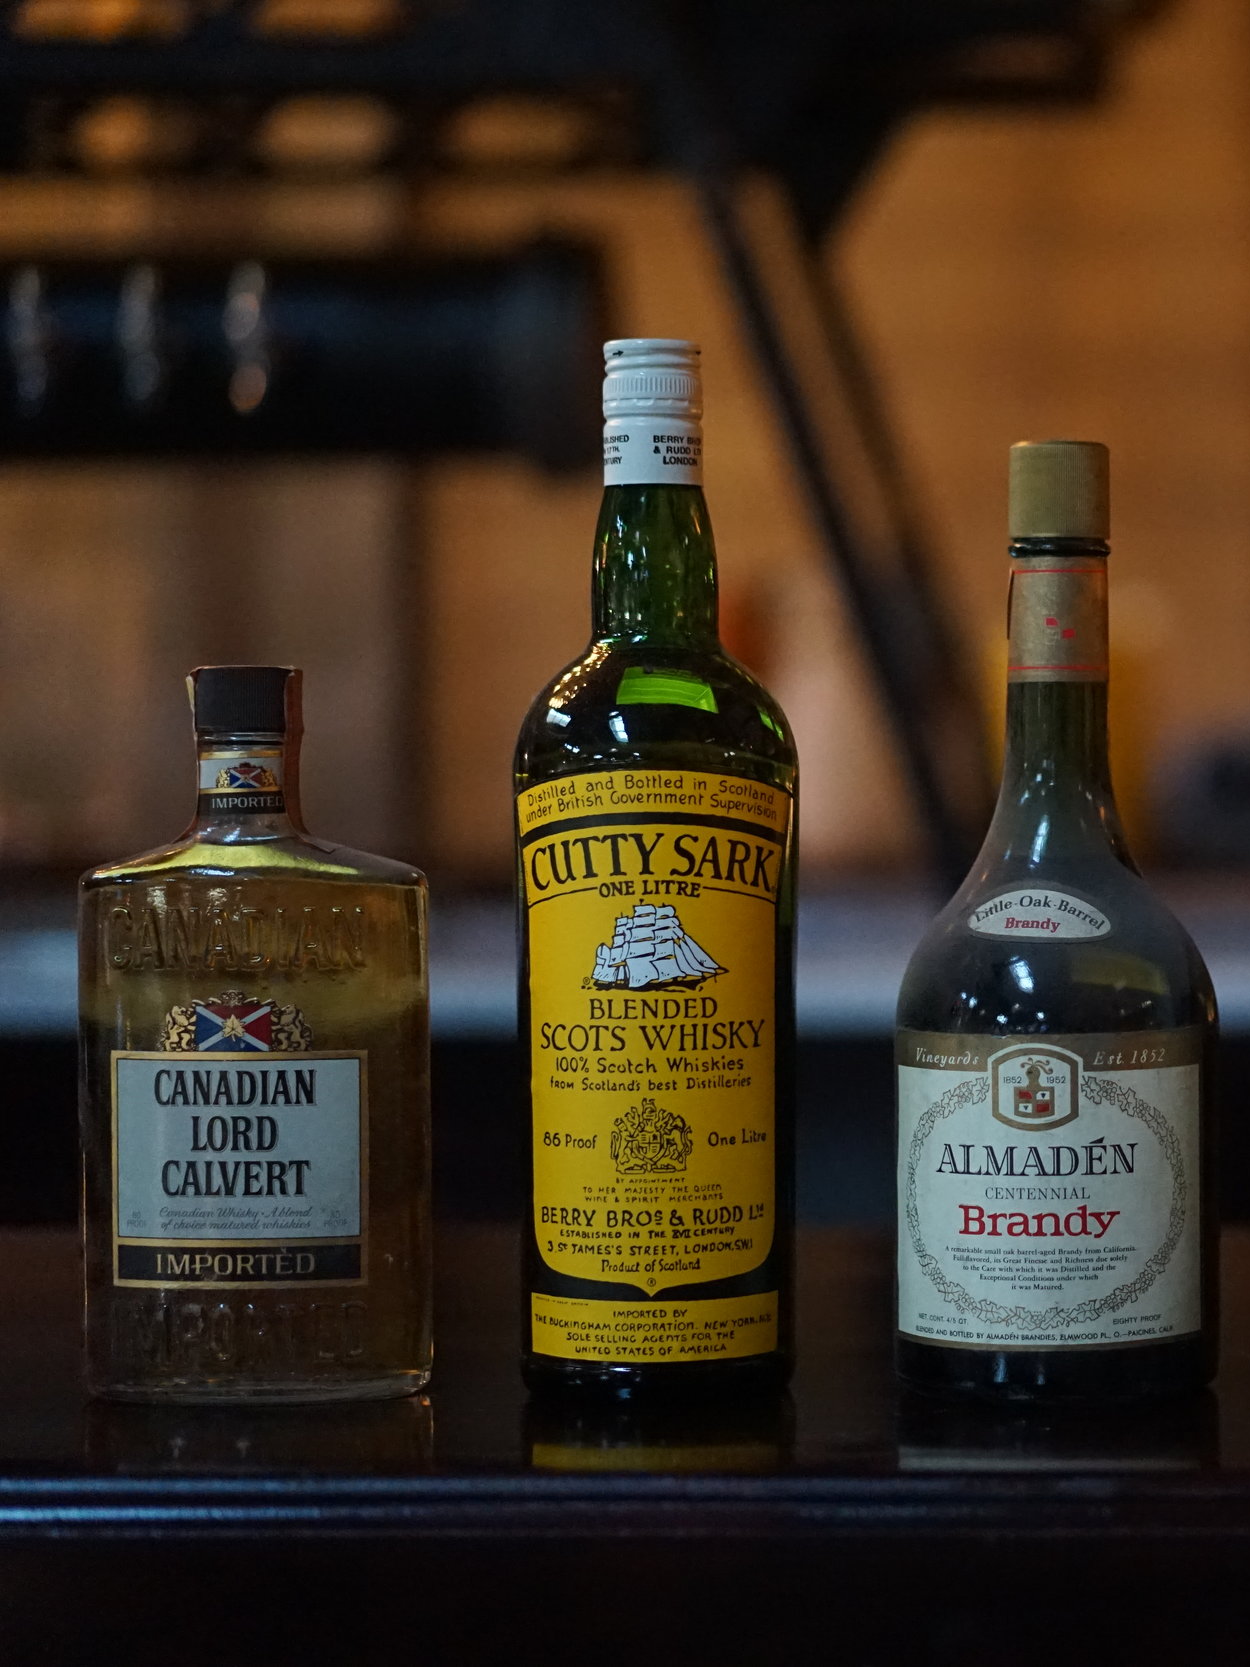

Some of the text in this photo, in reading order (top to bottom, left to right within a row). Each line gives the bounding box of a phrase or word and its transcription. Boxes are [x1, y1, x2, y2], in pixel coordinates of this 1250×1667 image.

[653, 435, 684, 444] BERRY
[653, 446, 691, 455] & RUDD
[663, 456, 698, 465] LONDON
[527, 775, 774, 806] Distilled and Bottled in Scotland
[212, 796, 282, 809] IMPORTED
[526, 791, 777, 823] under British Government Supervision
[531, 832, 775, 893] CUTTY SARK
[598, 880, 700, 898] ONE LITRE
[1005, 918, 1060, 932] Brandy
[589, 997, 718, 1020] BLENDED
[541, 1019, 765, 1052] SCOTS WHISKY
[915, 1047, 979, 1067] Vineyards
[1131, 1048, 1166, 1064] 1852
[556, 1056, 744, 1074] 100% Scotch Whiskies
[154, 1069, 317, 1106] CANADIAN
[582, 1078, 640, 1091] Scotland's
[649, 1079, 677, 1091] best
[686, 1075, 751, 1090] Distilleries
[1003, 1076, 1022, 1084] 1852
[1046, 1076, 1066, 1084] 1952
[191, 1115, 279, 1152] LORD
[543, 1133, 598, 1149] 86 Proof
[708, 1128, 766, 1146] One Litre
[936, 1136, 1138, 1177] ALMADÉN
[161, 1160, 310, 1197] CALVERT
[985, 1187, 1090, 1200] CENTENNIAL
[160, 1207, 214, 1218] Canadian
[542, 1206, 596, 1226] BERRY
[669, 1209, 684, 1226] &
[692, 1205, 743, 1225] RUDD
[173, 1220, 207, 1230] choice
[958, 1204, 1120, 1238] Brandy
[560, 1229, 621, 1238] ESTABLISHED
[629, 1230, 640, 1238] IN
[648, 1230, 666, 1238] THE
[156, 1252, 315, 1274] IMPORTED
[601, 1258, 701, 1272] Product of Scotland
[613, 1309, 687, 1318] IMPORTED BY
[1113, 1314, 1161, 1325] EIGHTY PROOF
